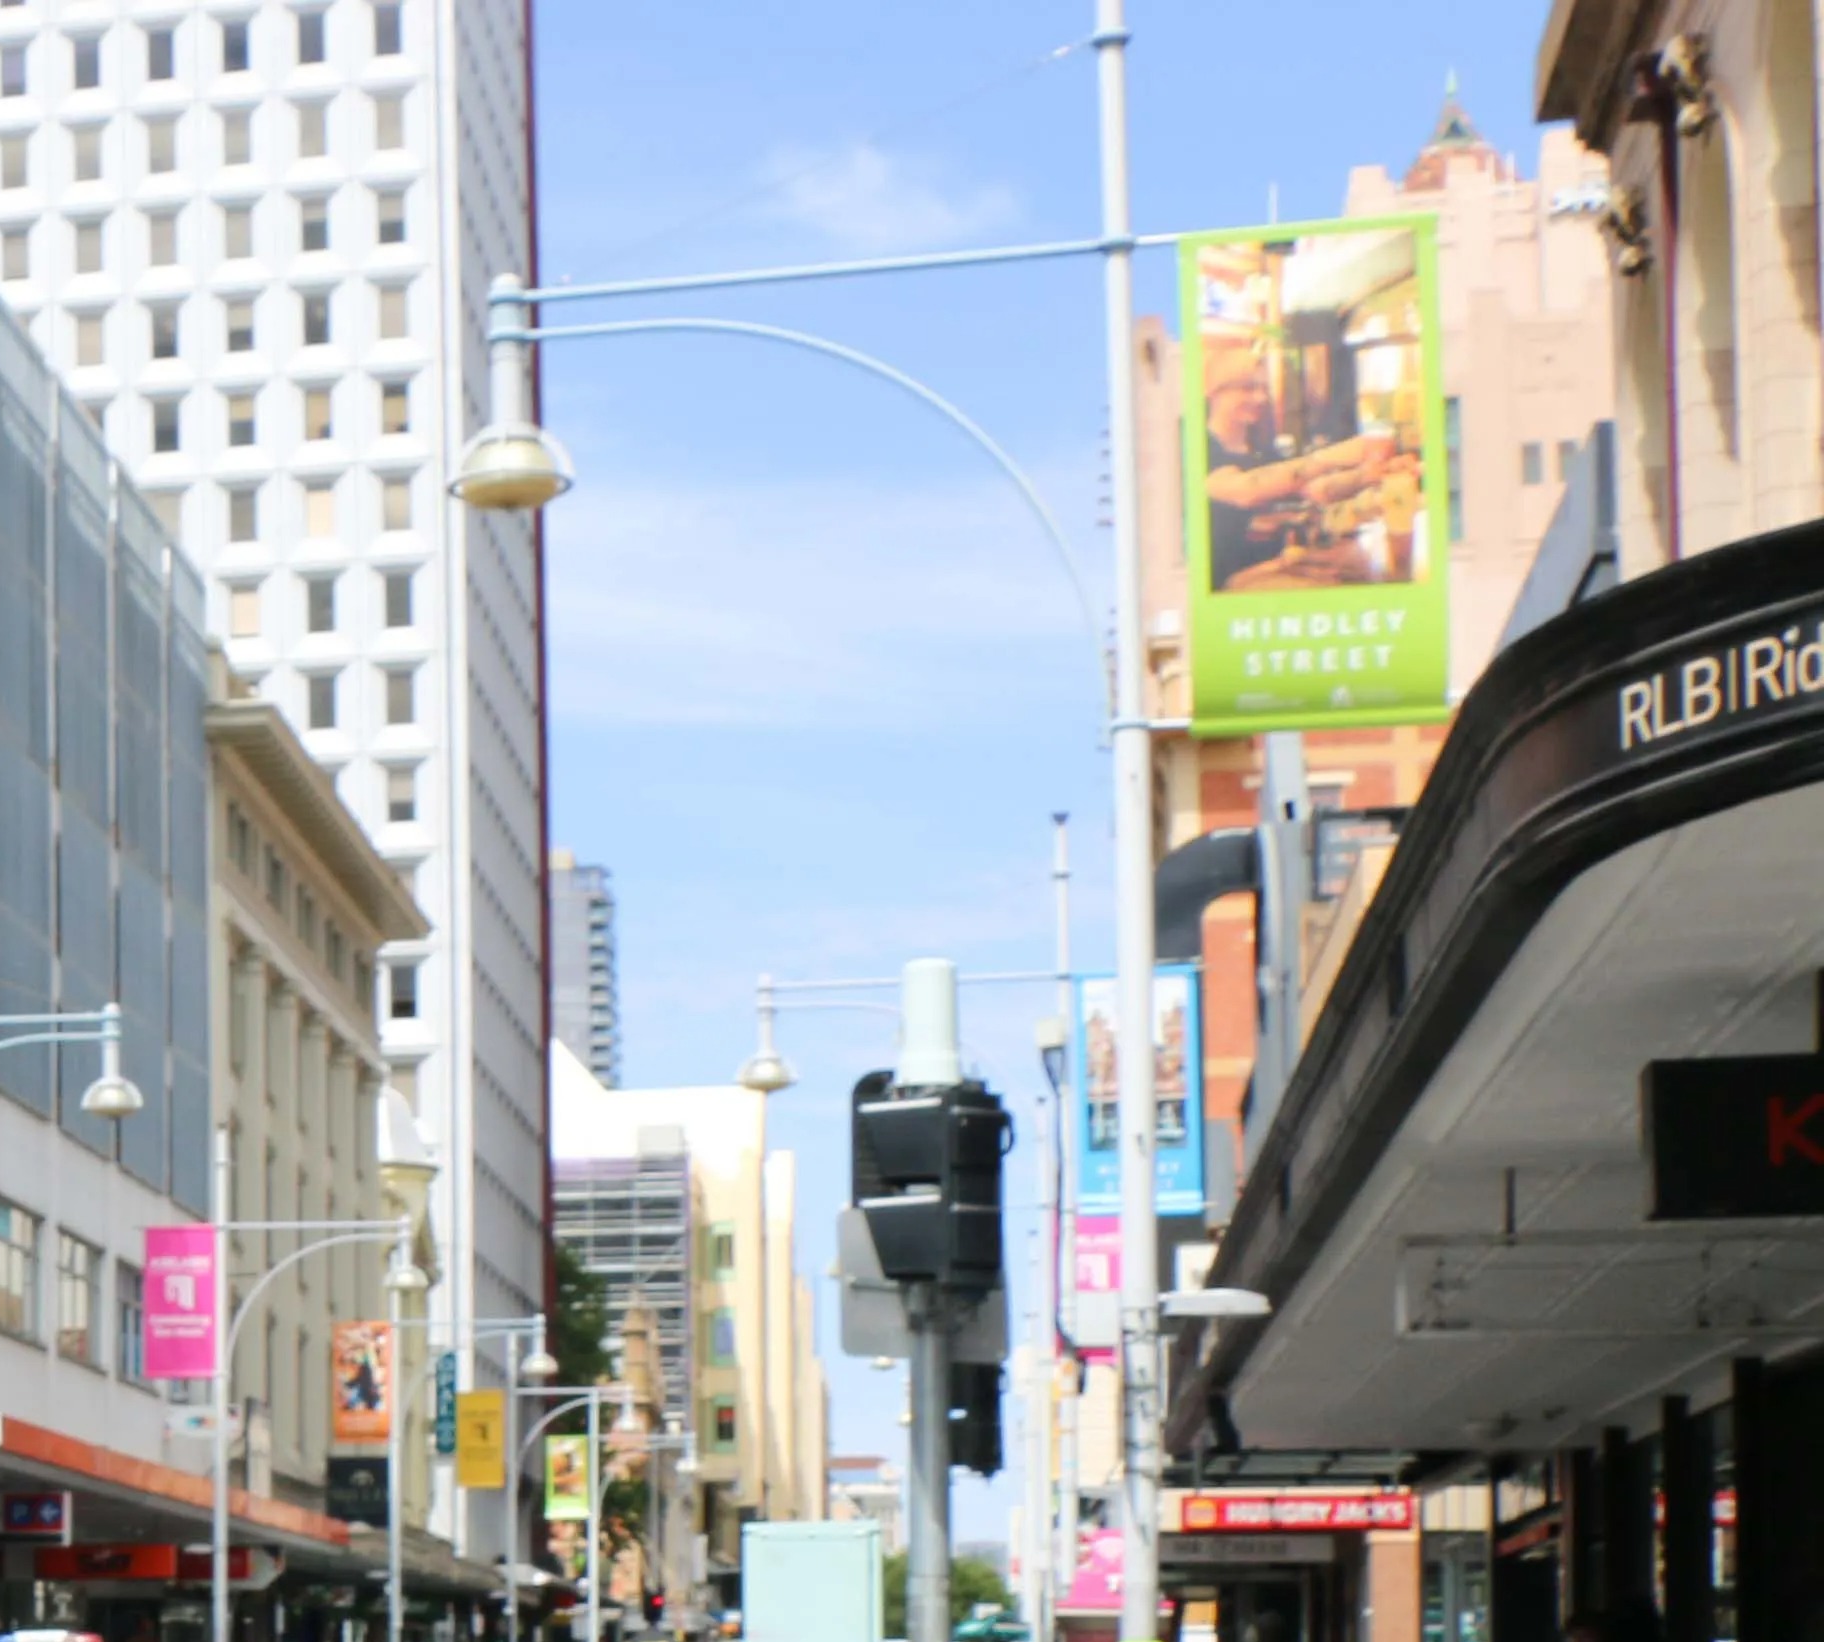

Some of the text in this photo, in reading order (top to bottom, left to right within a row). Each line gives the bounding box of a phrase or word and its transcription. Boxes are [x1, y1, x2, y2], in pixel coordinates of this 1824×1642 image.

[1229, 608, 1407, 641] HINDLEY
[1244, 645, 1394, 677] STREET
[1225, 1500, 1332, 1526] HUNGRY
